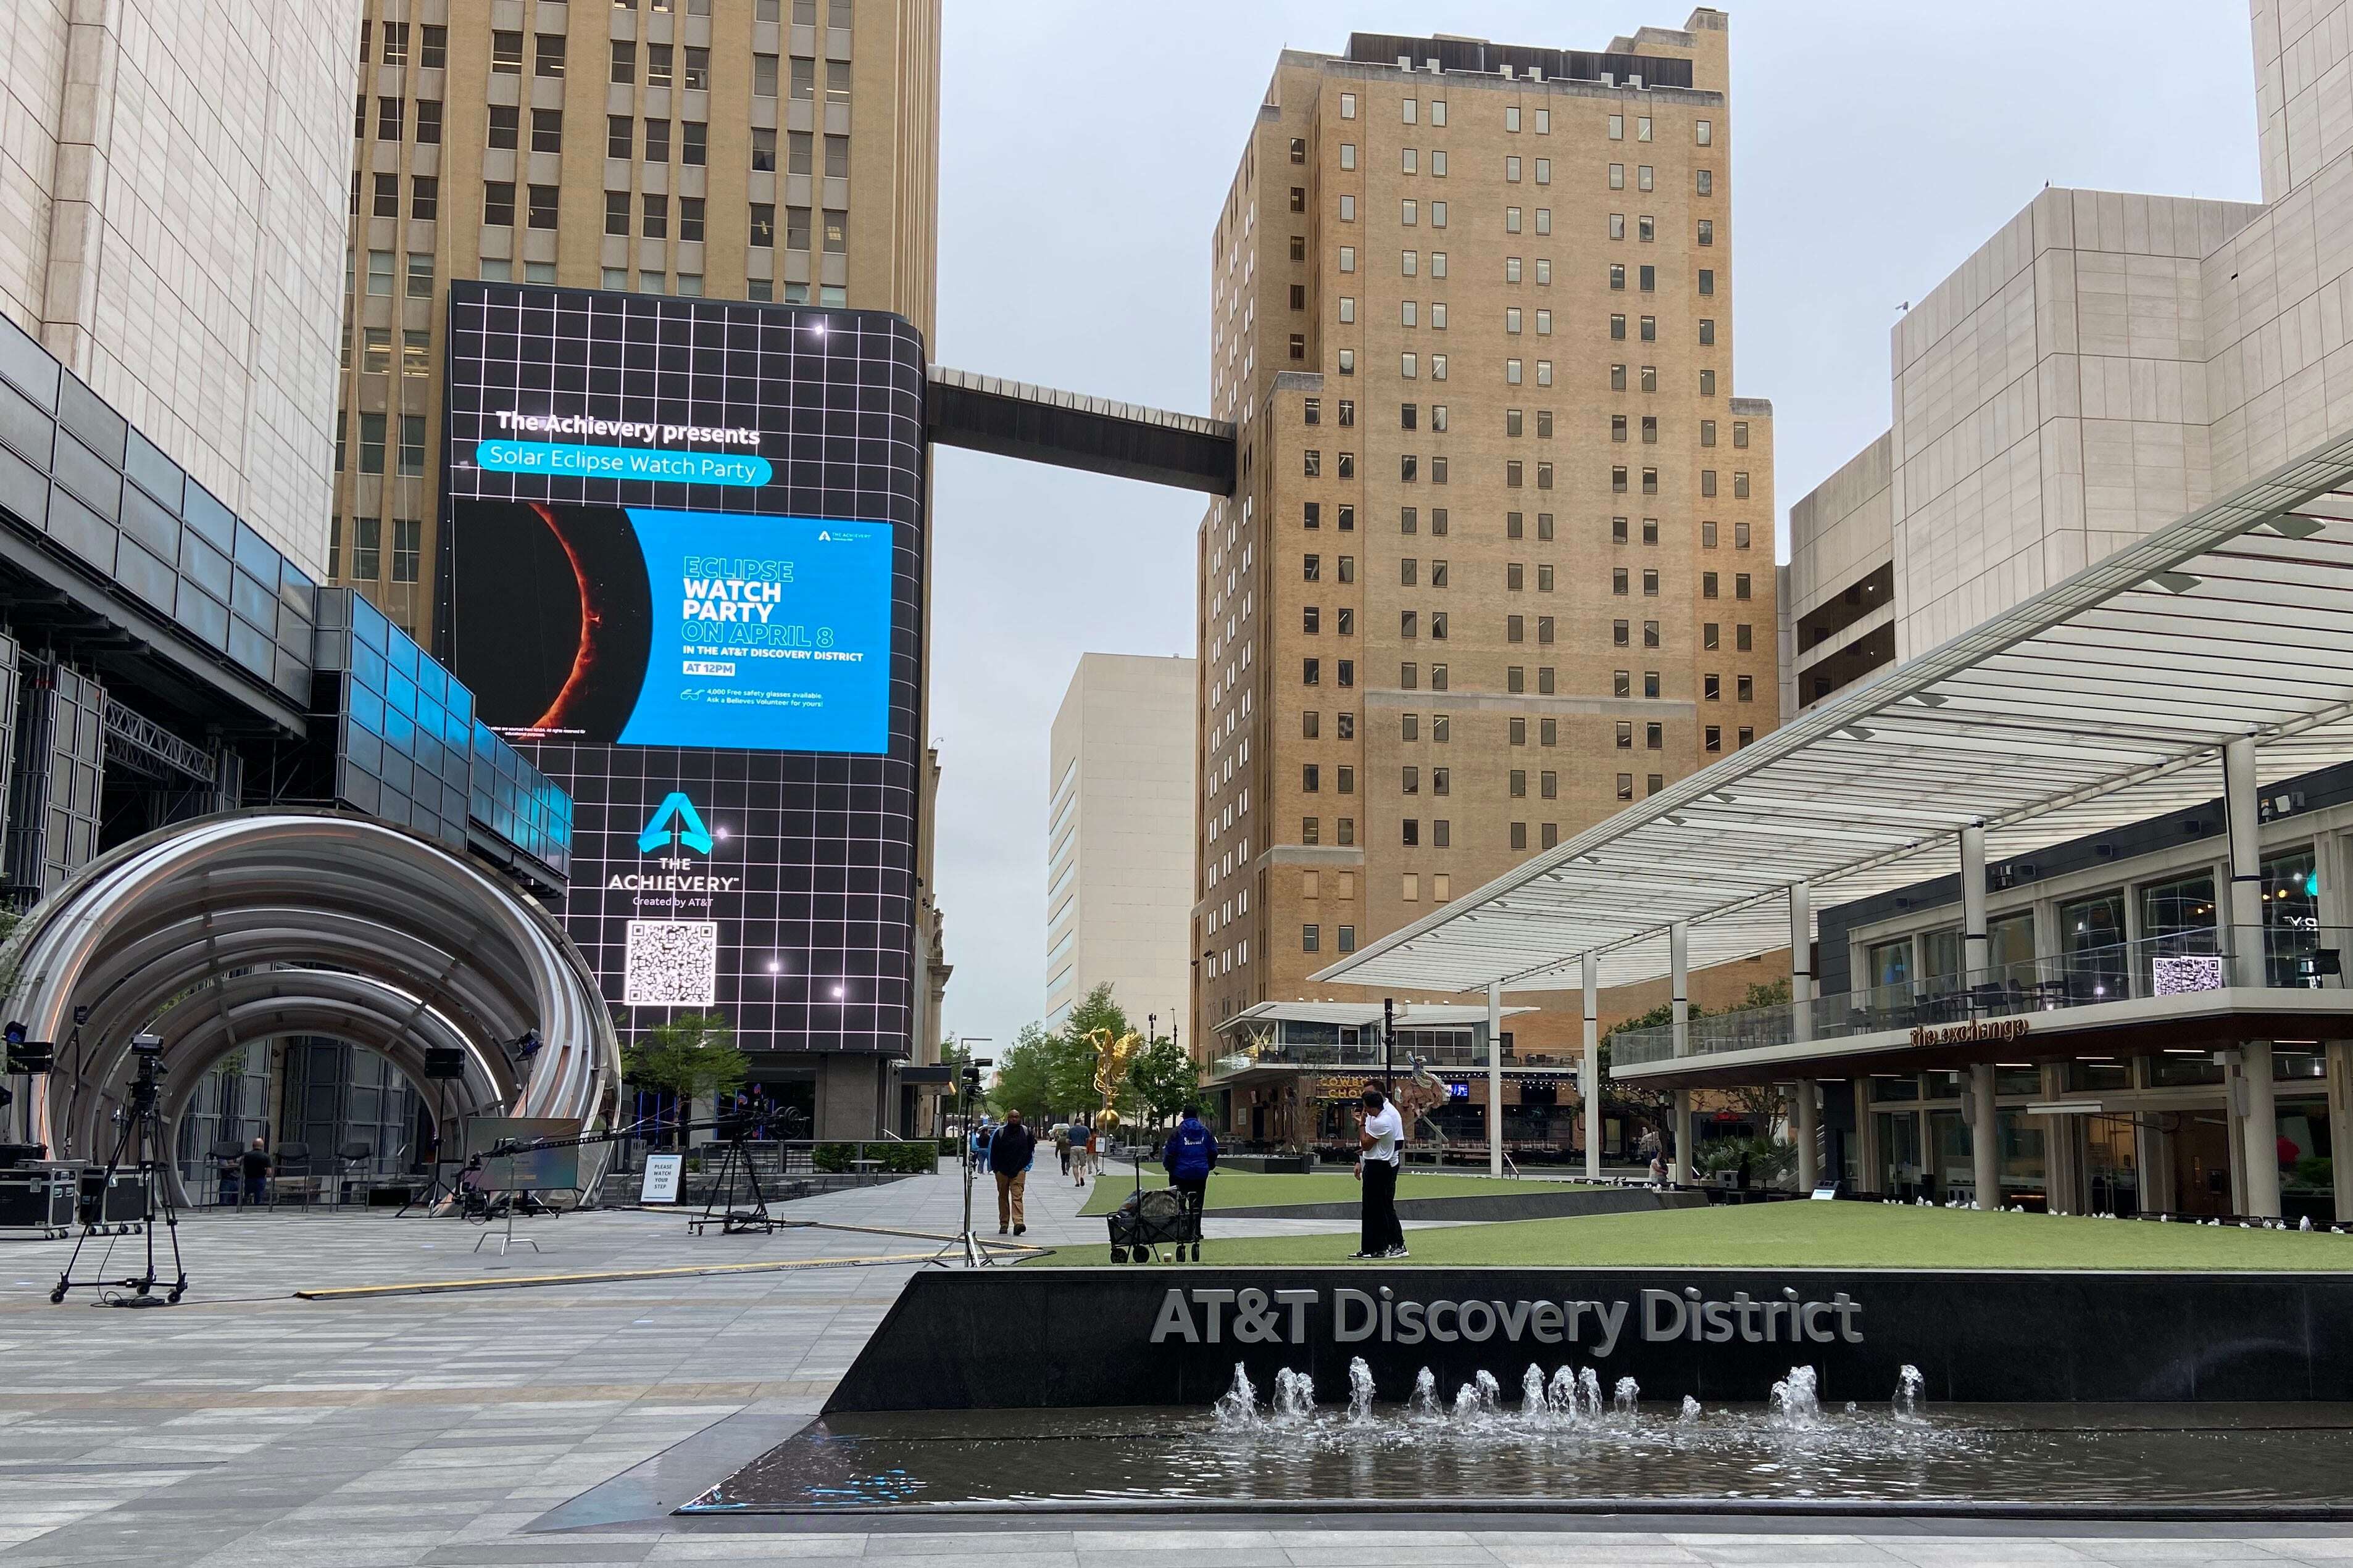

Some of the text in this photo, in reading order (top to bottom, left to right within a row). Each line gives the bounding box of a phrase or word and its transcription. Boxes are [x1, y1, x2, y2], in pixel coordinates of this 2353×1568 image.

[496, 411, 760, 445] The Achievery presents
[490, 446, 757, 483] Solar Eclipse Watch Party
[684, 556, 794, 583] ECLIPSE
[683, 578, 781, 603] WATCH
[683, 599, 775, 623] PARTY
[681, 620, 834, 648] ON APRIL 8
[683, 645, 864, 662] IN THE AT&T DISCOVERY DISTRICT
[686, 663, 733, 673] AT 12PM
[743, 689, 764, 698] safety
[766, 691, 791, 699] glasses
[659, 857, 691, 871] THE
[633, 897, 713, 908] Created by AT&T
[1909, 1018, 2029, 1047] the exchange
[1320, 1077, 1368, 1087] COWBO
[1149, 1286, 1865, 1357] AT&T Discovery District
